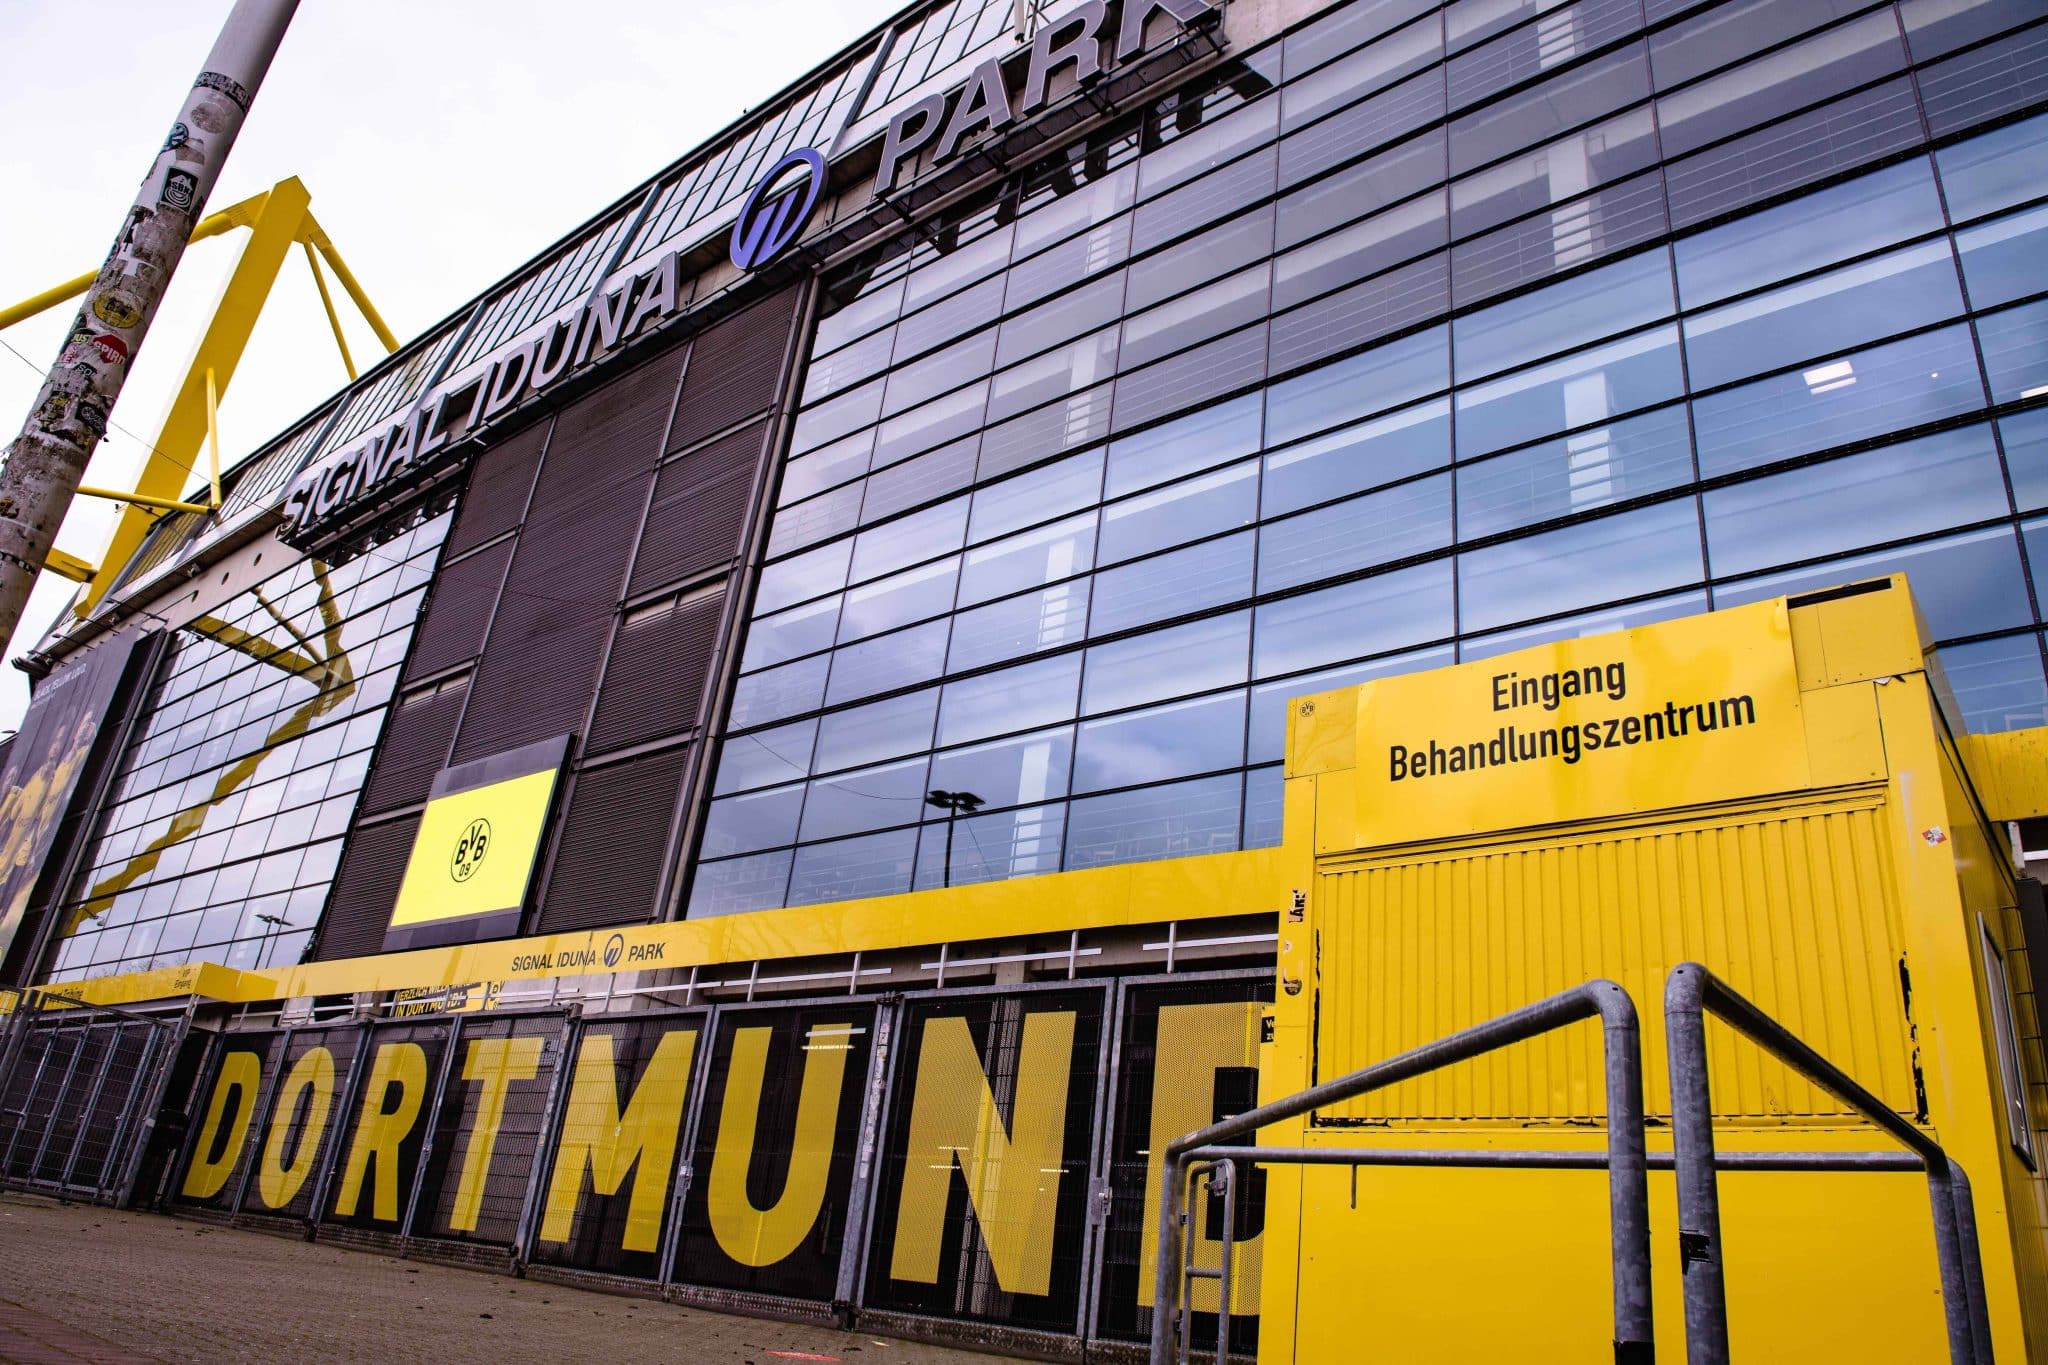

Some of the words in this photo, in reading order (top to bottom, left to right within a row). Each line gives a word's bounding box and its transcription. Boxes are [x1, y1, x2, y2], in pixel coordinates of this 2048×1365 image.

[275, 392, 452, 542] SIGNAL
[466, 251, 681, 432] IDUNA
[874, 0, 1213, 199] PARK
[1491, 661, 1627, 712] Eingang
[1389, 693, 1756, 782] Behandlungszentrum
[455, 823, 487, 866] BVB
[459, 862, 471, 877] 09
[511, 953, 553, 972] SIGNAL
[556, 950, 597, 968] IDUNA
[628, 943, 665, 962] PARK
